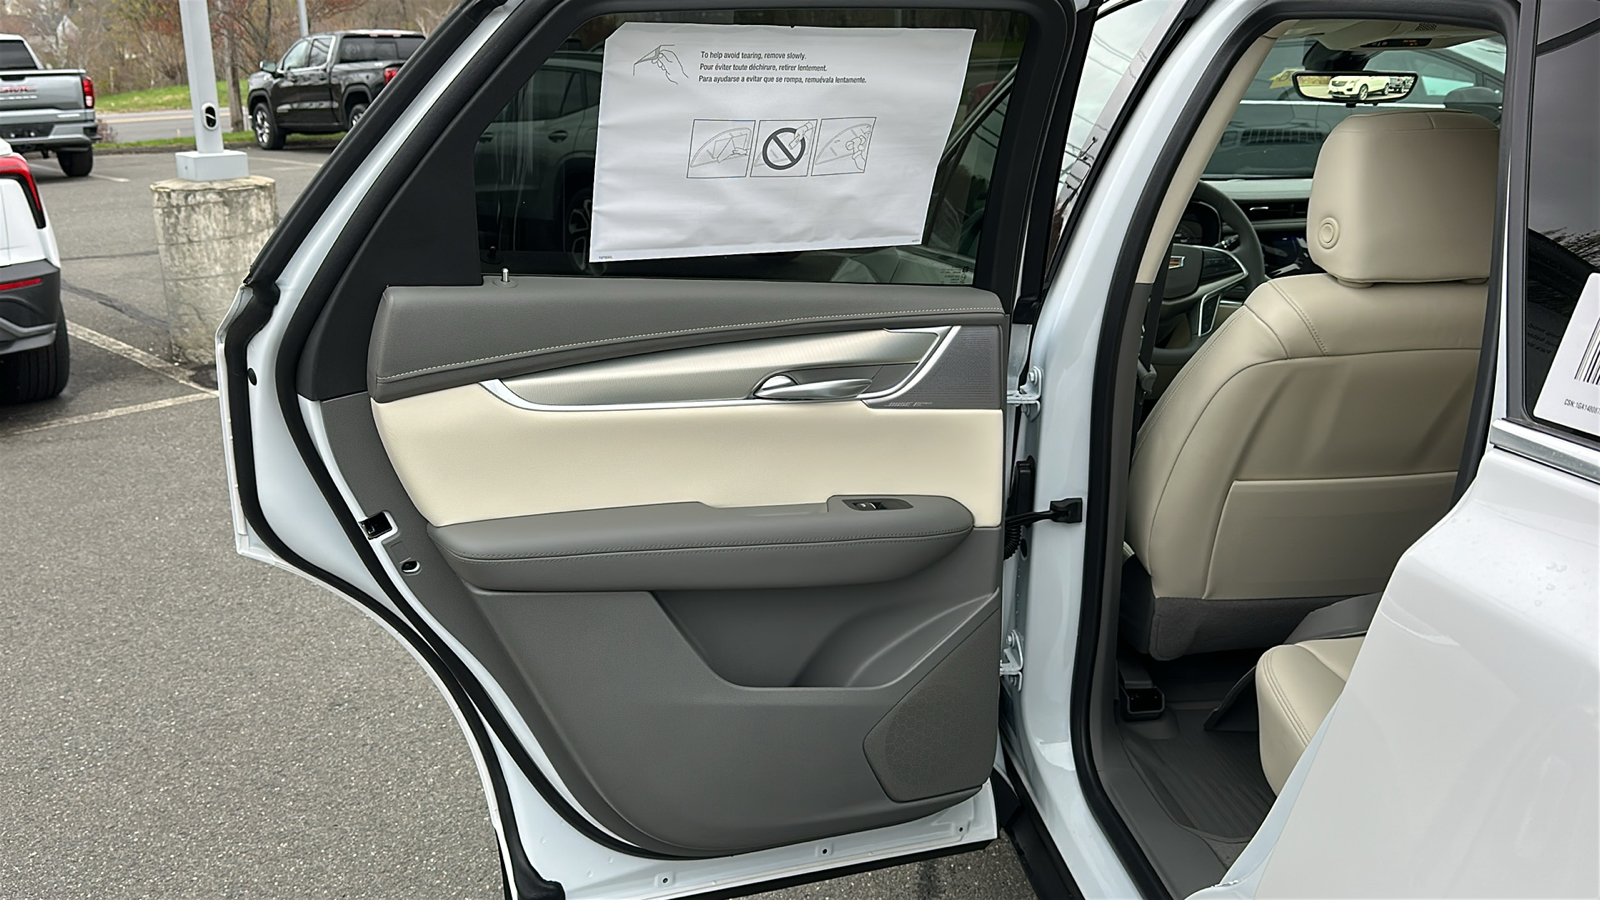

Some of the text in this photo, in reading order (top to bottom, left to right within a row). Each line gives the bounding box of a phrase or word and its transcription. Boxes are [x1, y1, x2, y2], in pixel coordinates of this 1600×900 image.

[701, 51, 709, 59] To
[710, 51, 723, 60] help
[741, 52, 763, 60] tearing,
[787, 52, 807, 60] slowly.
[699, 63, 714, 71] Pour
[715, 63, 732, 71] éviter
[749, 63, 778, 71] déchirure,
[798, 64, 828, 72] lentement.
[835, 76, 867, 84] lentamente.
